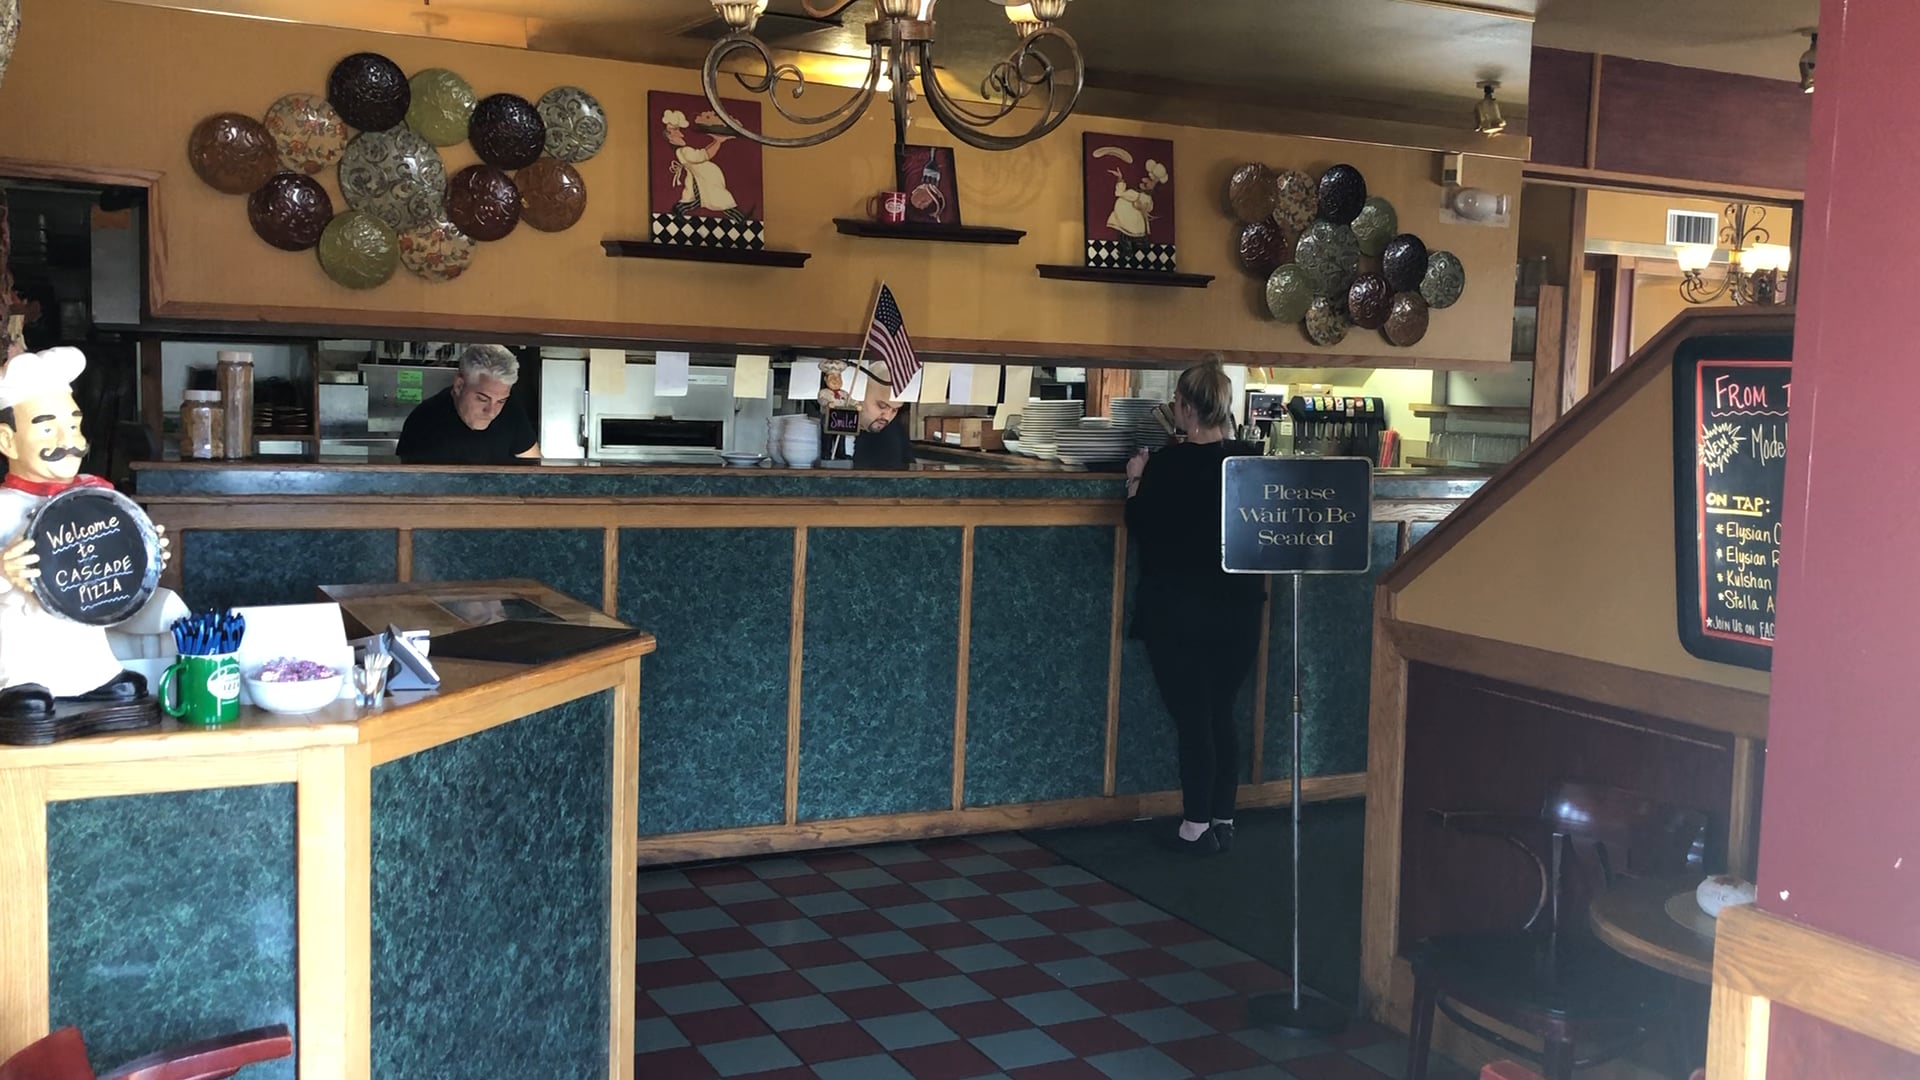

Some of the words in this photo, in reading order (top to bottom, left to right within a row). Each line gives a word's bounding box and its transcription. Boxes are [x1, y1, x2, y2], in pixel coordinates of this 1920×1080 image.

[1715, 374, 1768, 409] FROM
[830, 411, 858, 429] Smile!
[1704, 433, 1729, 462] NEW
[1263, 484, 1336, 500] Please
[1705, 492, 1728, 507] ON
[1732, 496, 1771, 513] TAP:
[1238, 507, 1288, 524] Wait
[1292, 507, 1323, 524] To
[1326, 507, 1356, 524] Be
[46, 516, 120, 549] Welcome
[1258, 530, 1334, 546] Seated
[1726, 521, 1771, 545] Elysian
[77, 544, 95, 558] to
[1726, 545, 1767, 572] Elysian
[55, 555, 132, 586] CASCADE
[1726, 569, 1772, 591] Kulshan
[79, 578, 122, 603] PIZZA
[1724, 589, 1759, 611] Stella
